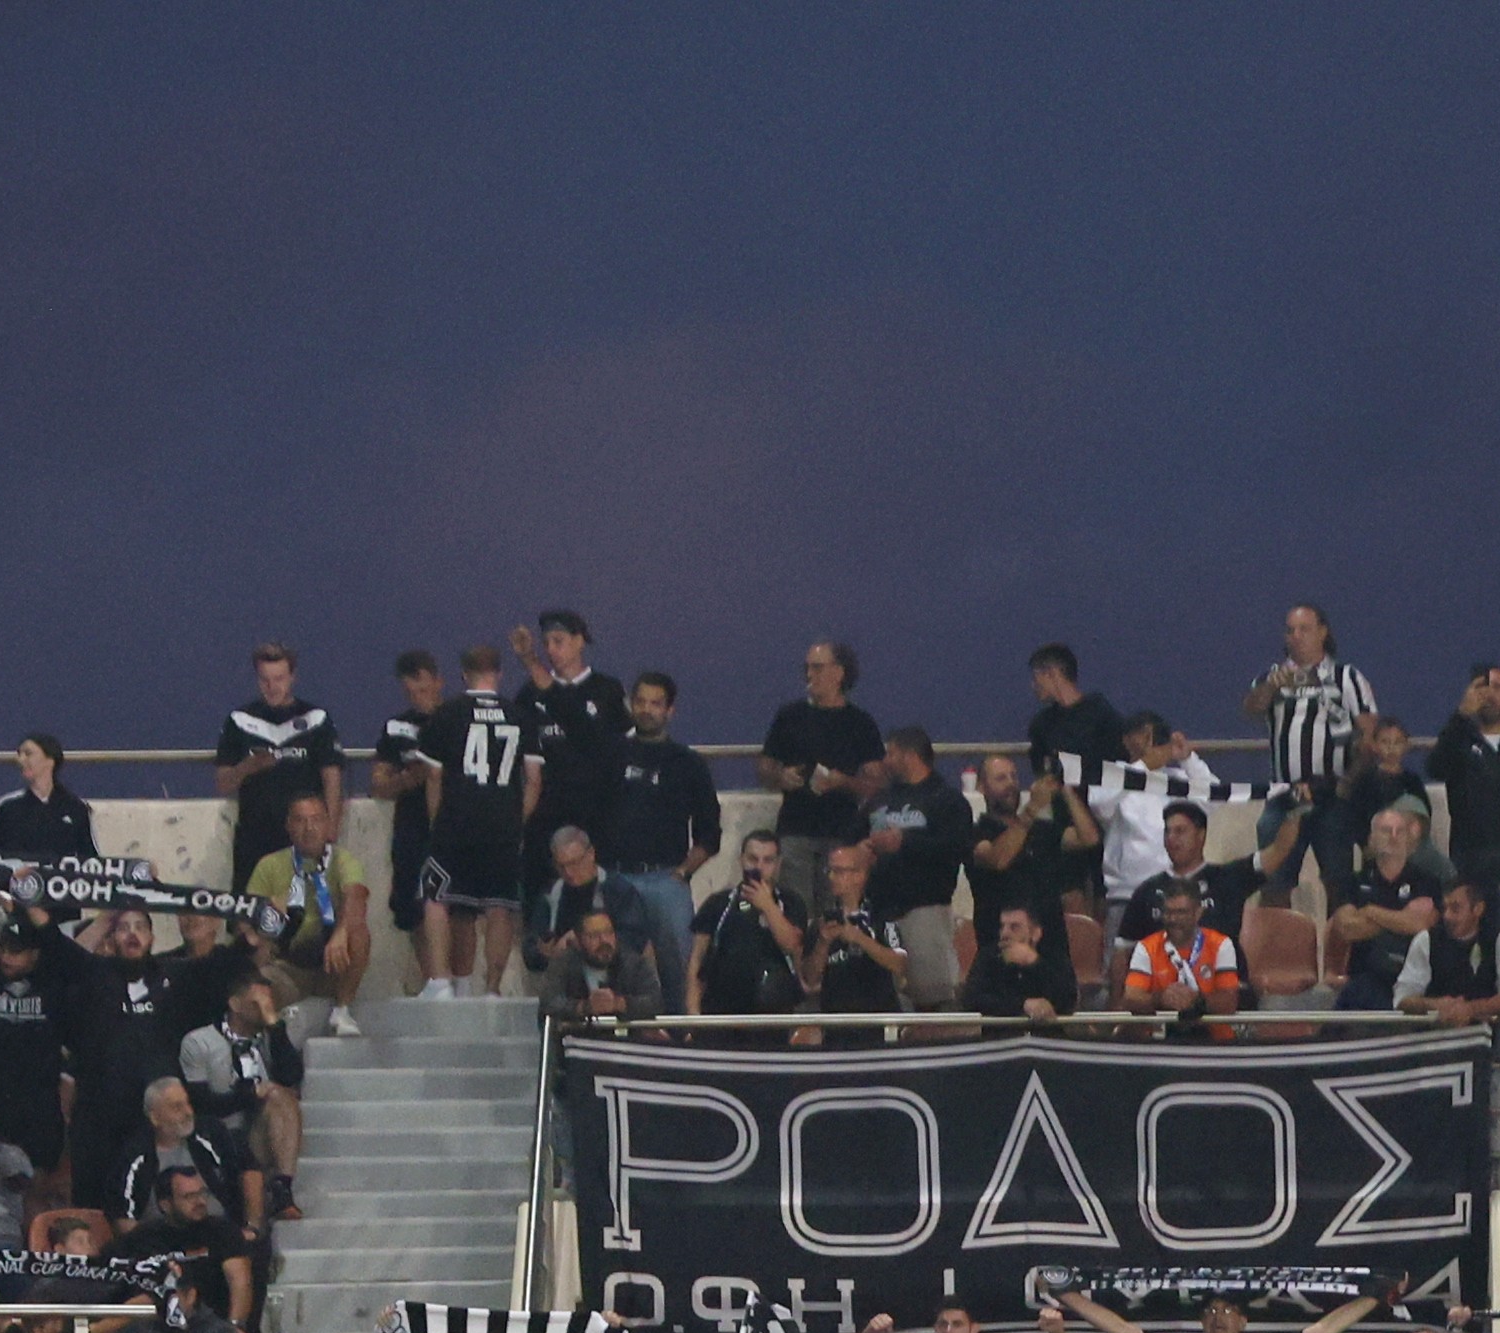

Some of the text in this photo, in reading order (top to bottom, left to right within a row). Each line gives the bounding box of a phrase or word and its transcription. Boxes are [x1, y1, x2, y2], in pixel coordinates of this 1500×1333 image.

[463, 724, 520, 785] 47
[46, 874, 113, 902] ΟΦΗ
[595, 1061, 1473, 1255] ΡΟΔΟΣ
